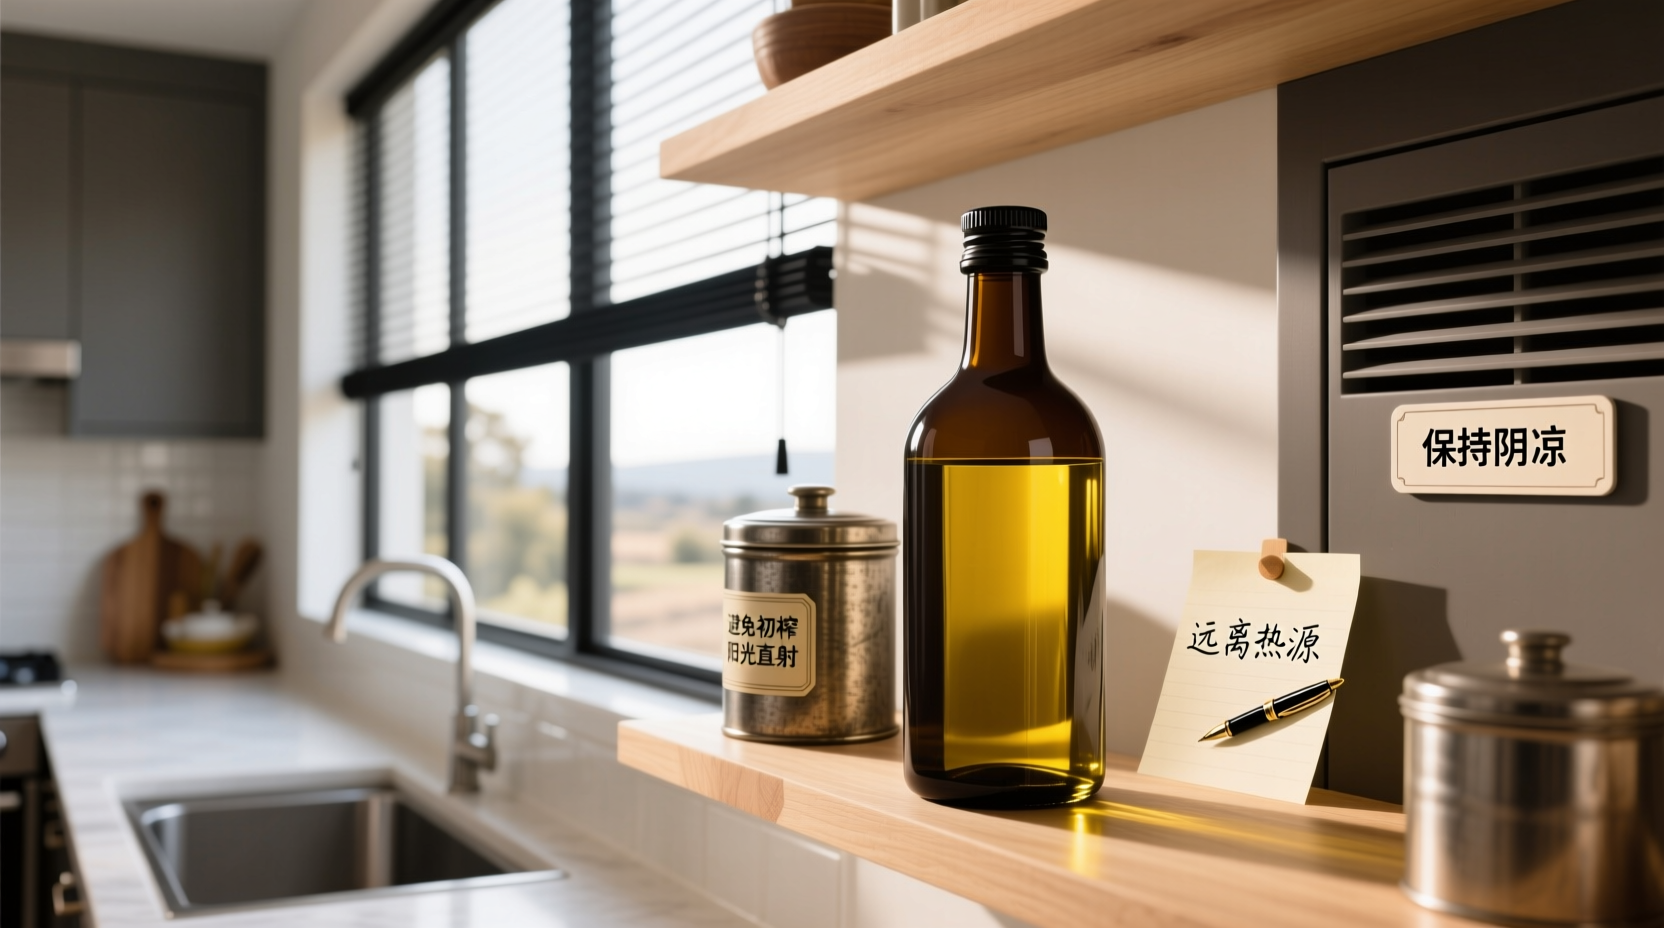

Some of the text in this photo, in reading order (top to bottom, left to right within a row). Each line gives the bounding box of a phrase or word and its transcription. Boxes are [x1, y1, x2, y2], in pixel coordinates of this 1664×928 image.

[1422, 425, 1566, 467] 保持阴凉
[1187, 618, 1320, 664] 远离热源
